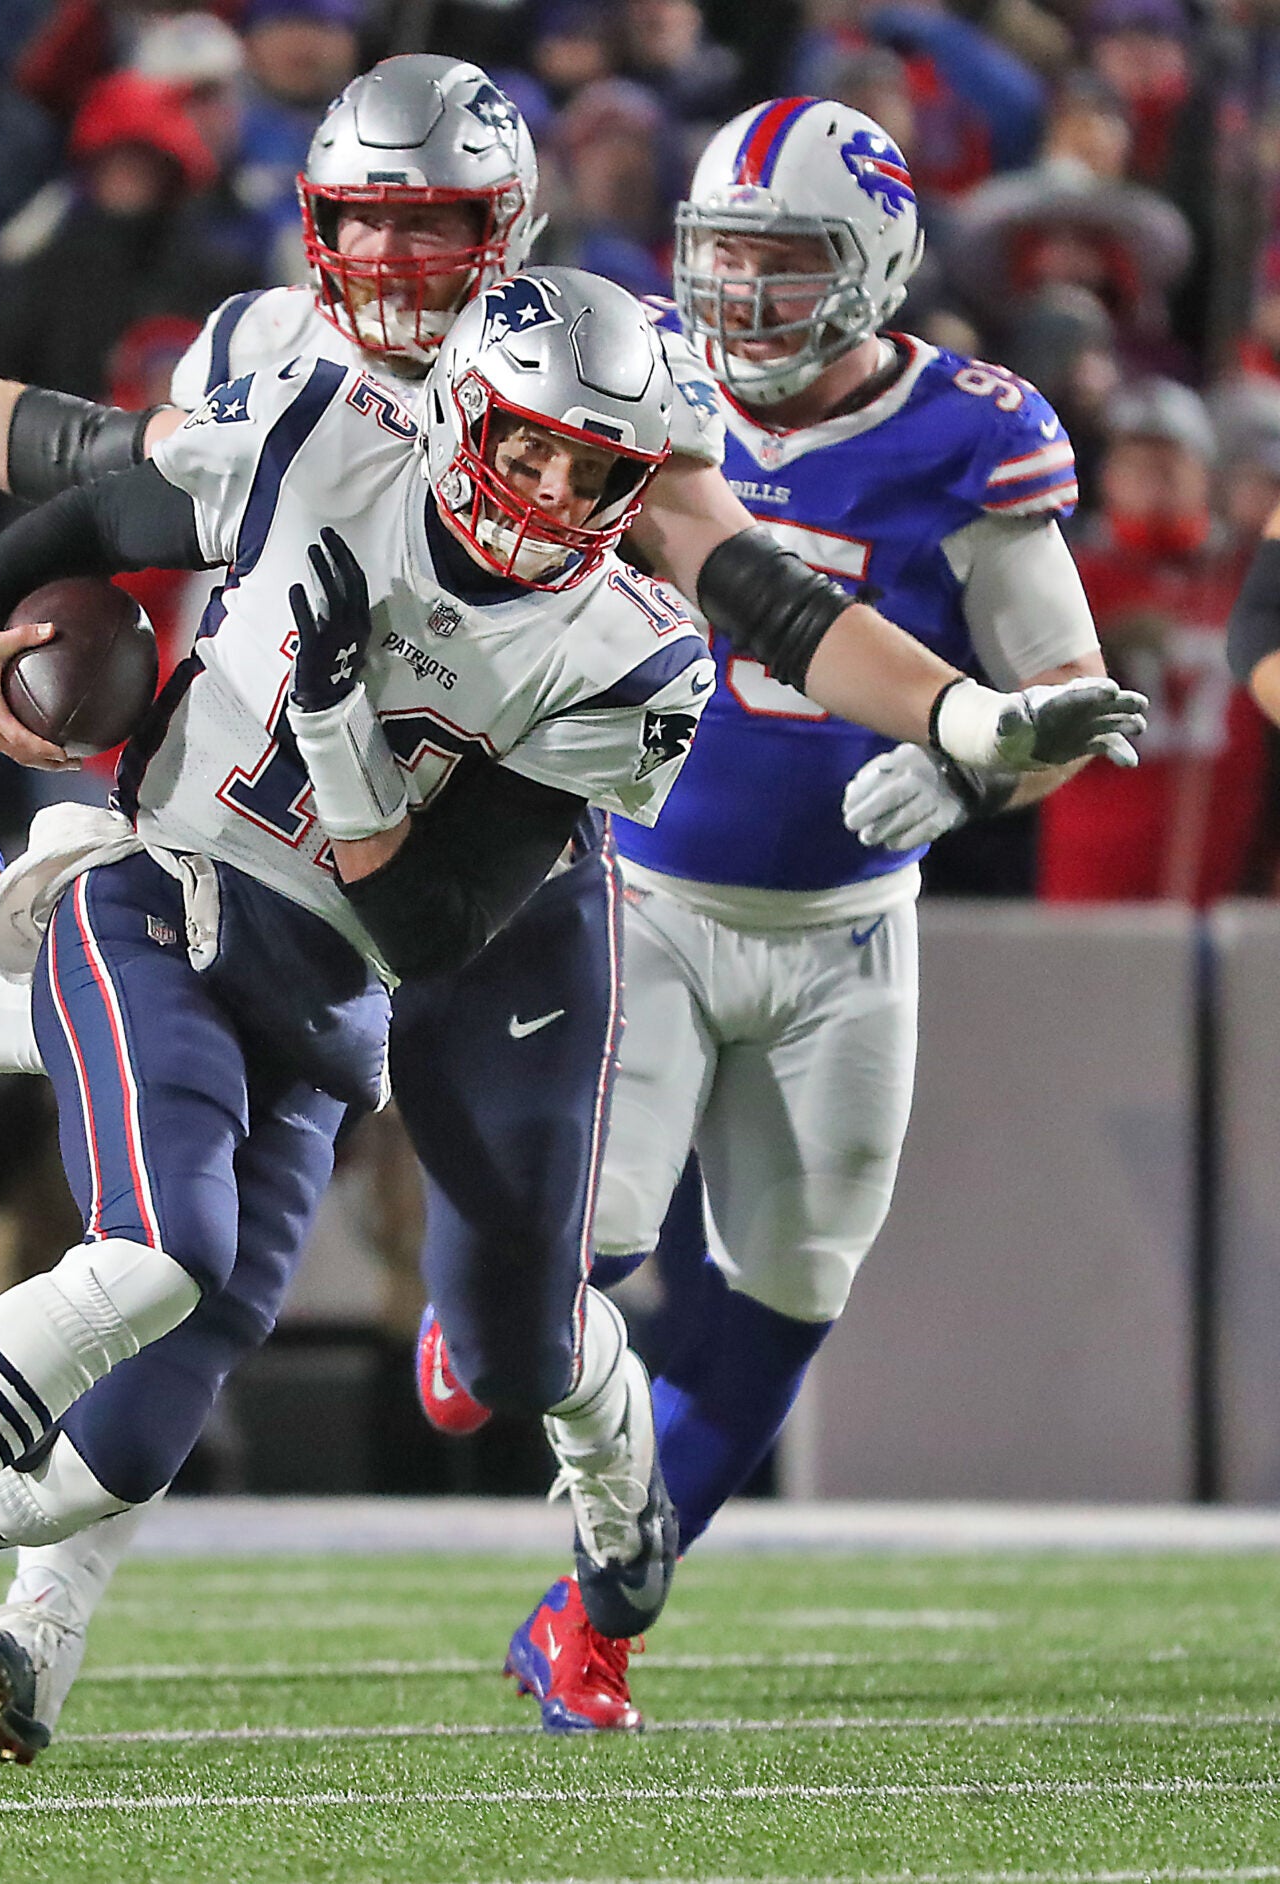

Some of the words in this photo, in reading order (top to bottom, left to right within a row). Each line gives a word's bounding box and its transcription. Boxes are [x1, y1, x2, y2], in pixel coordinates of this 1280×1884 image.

[345, 371, 419, 441] 2
[953, 360, 1038, 412] 9
[728, 480, 792, 504] BILLS
[381, 631, 458, 691] PATRIOTS
